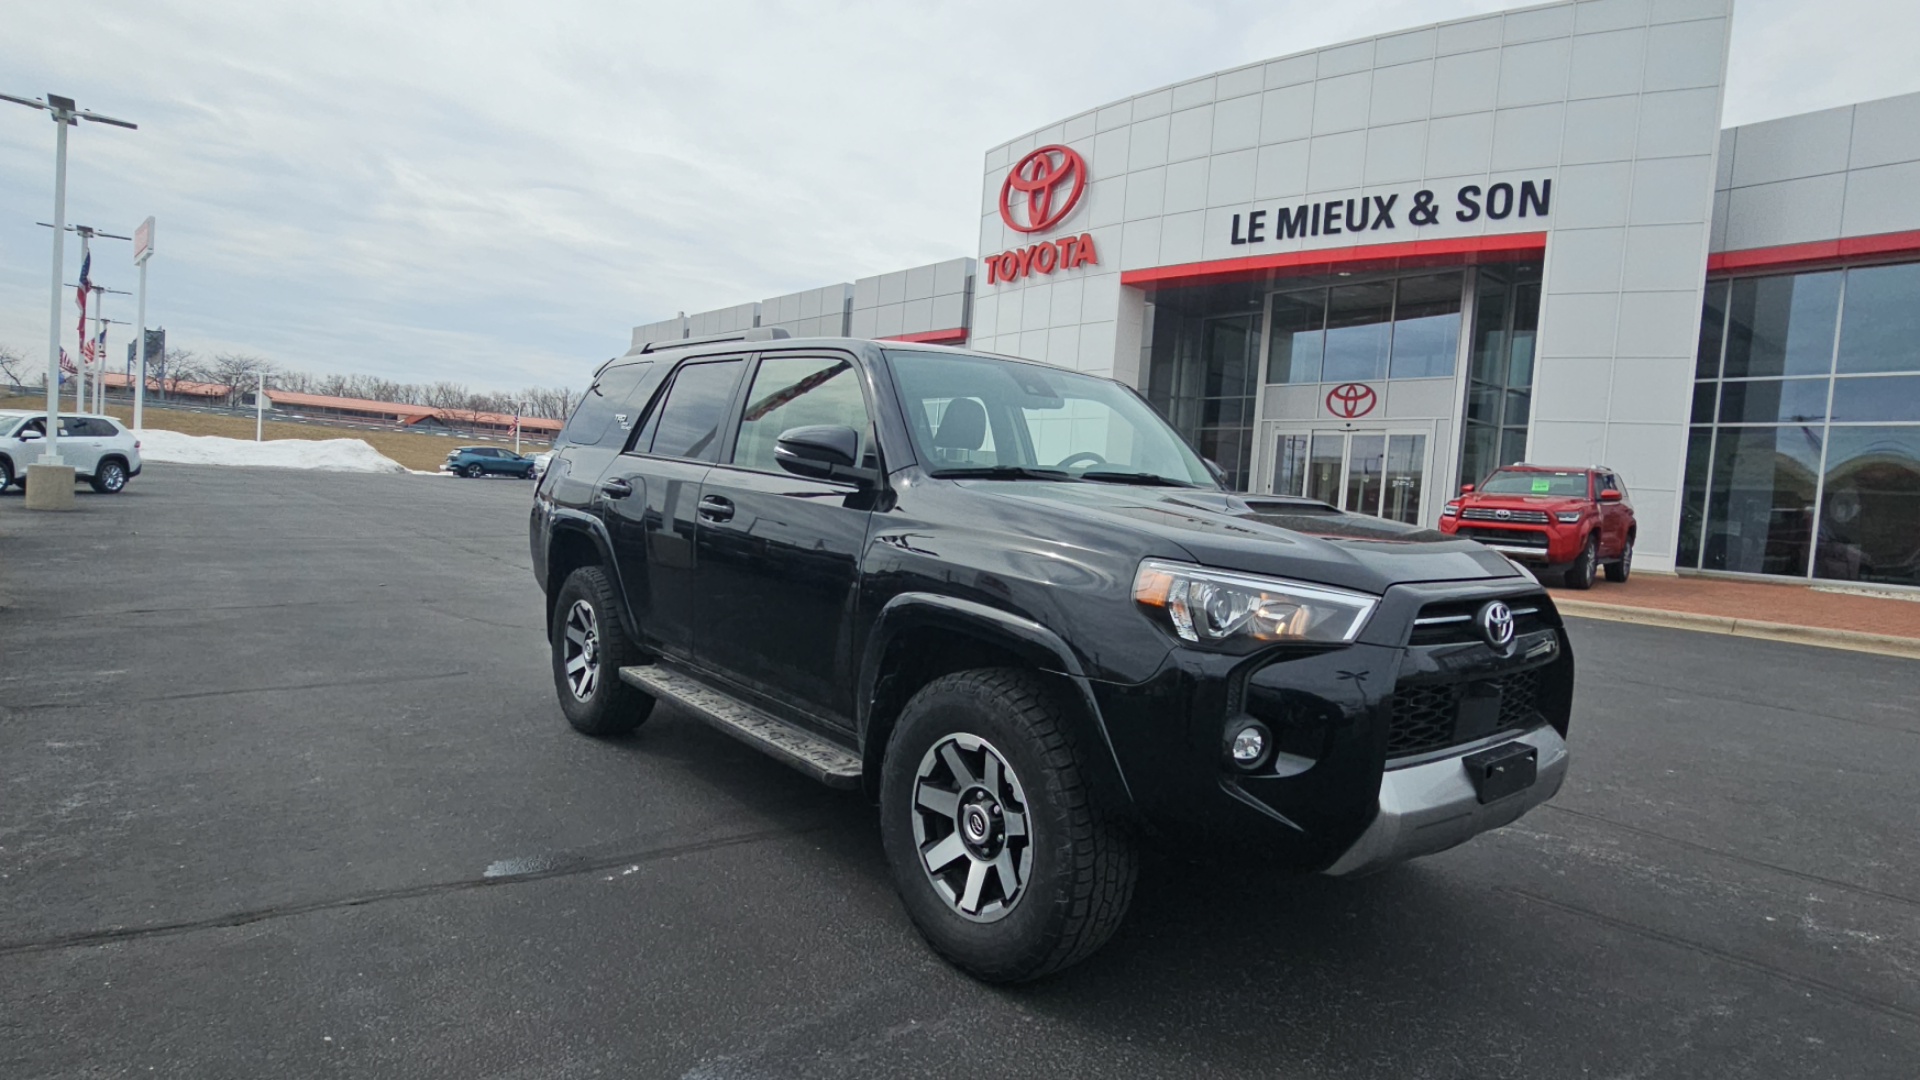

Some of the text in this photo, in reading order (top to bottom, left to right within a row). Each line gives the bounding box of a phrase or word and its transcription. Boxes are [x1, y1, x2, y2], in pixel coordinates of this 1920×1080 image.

[1231, 178, 1552, 245] LE MIEUX & SON
[984, 232, 1098, 285] TOYOTA
